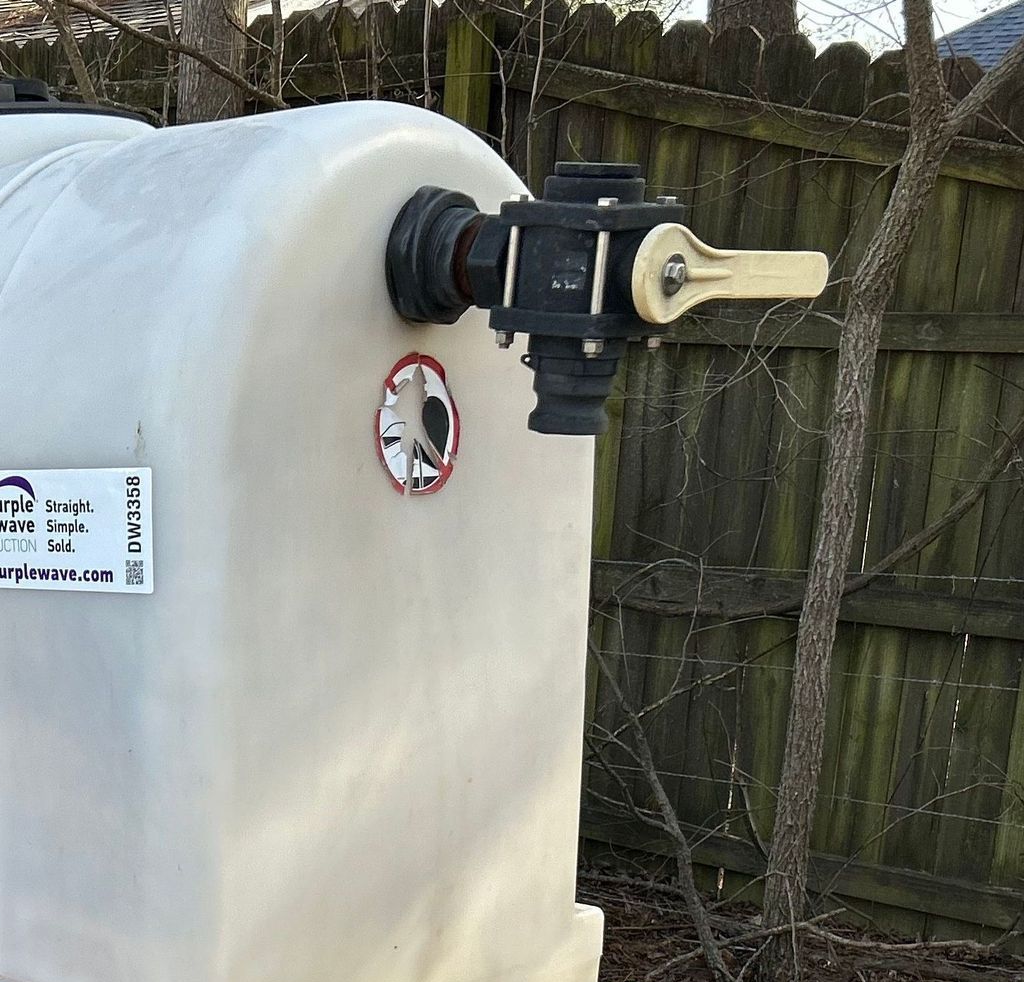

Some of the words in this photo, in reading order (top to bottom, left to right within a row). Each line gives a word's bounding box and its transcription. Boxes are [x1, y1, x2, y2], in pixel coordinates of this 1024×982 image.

[45, 499, 94, 516] Straight.
[126, 475, 142, 553] DW3358
[46, 519, 89, 535] Simple.
[47, 539, 76, 553] Sold.
